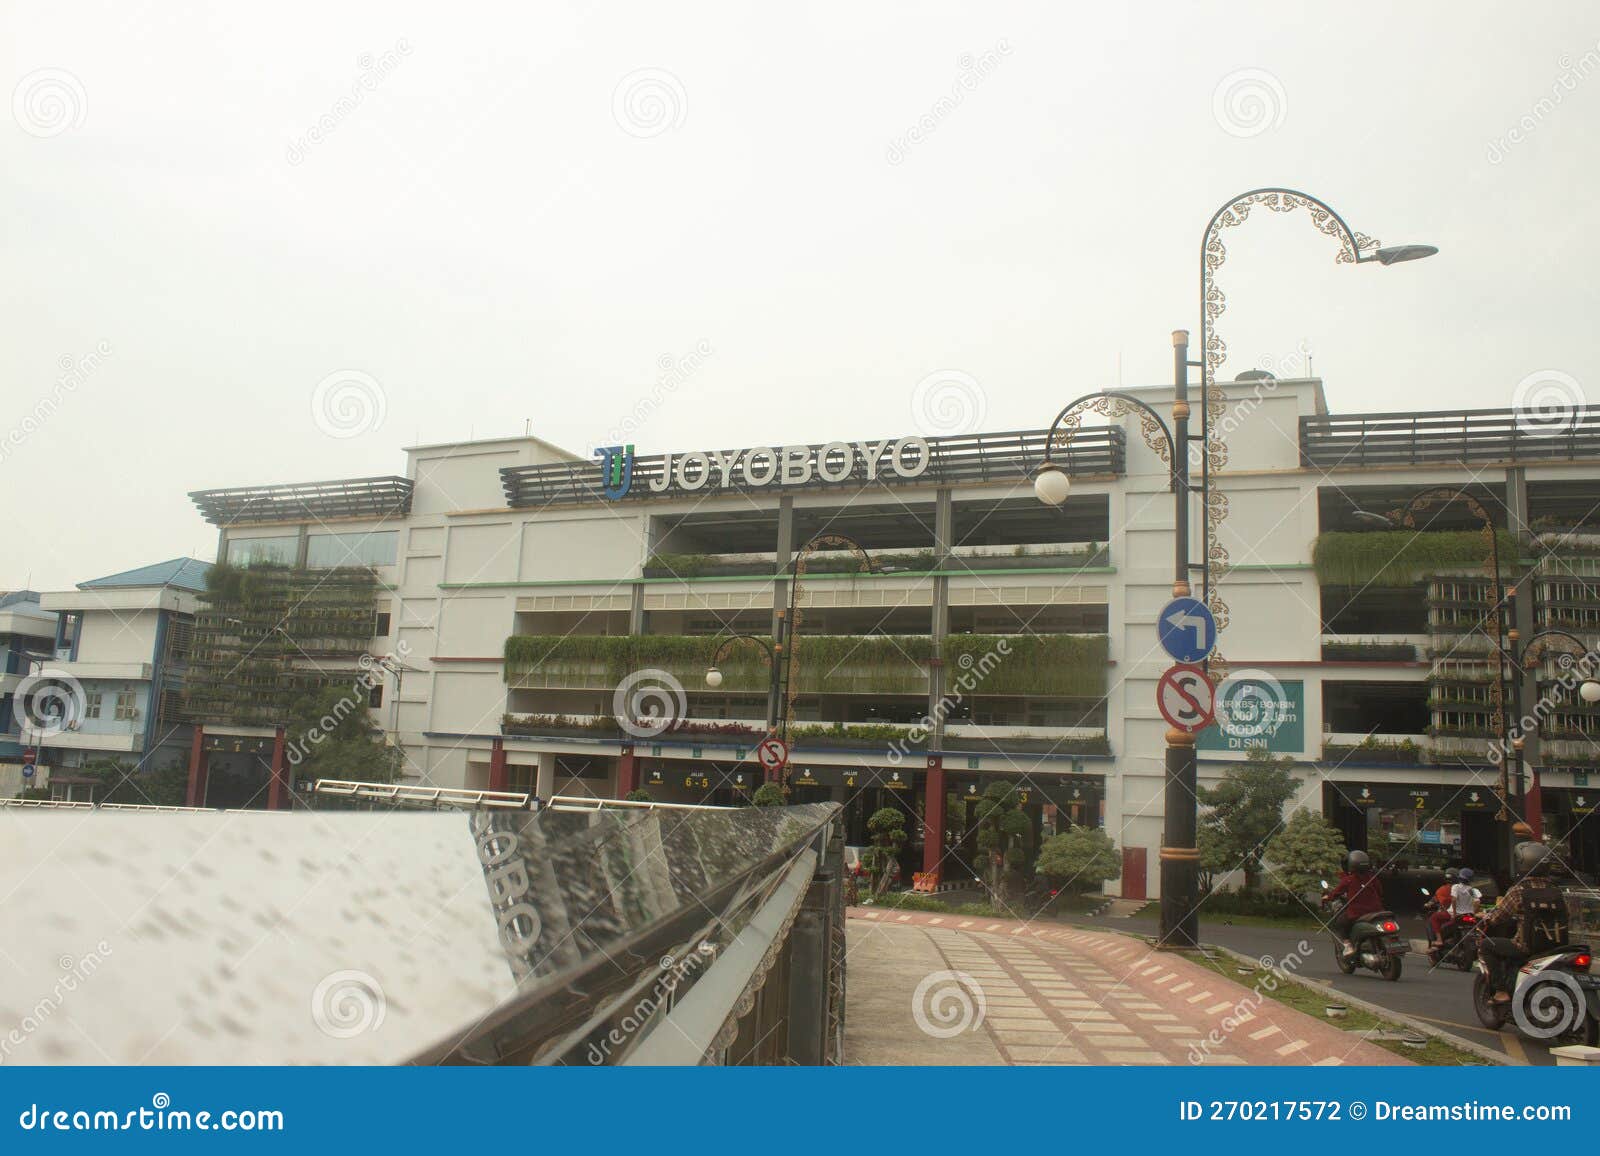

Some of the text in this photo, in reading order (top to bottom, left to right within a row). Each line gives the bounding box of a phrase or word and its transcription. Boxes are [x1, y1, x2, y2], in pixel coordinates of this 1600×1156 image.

[649, 435, 930, 493] JOYOBOYO
[1228, 738, 1268, 749] DI SINI
[846, 776, 854, 787] 4
[1416, 797, 1425, 809] 2
